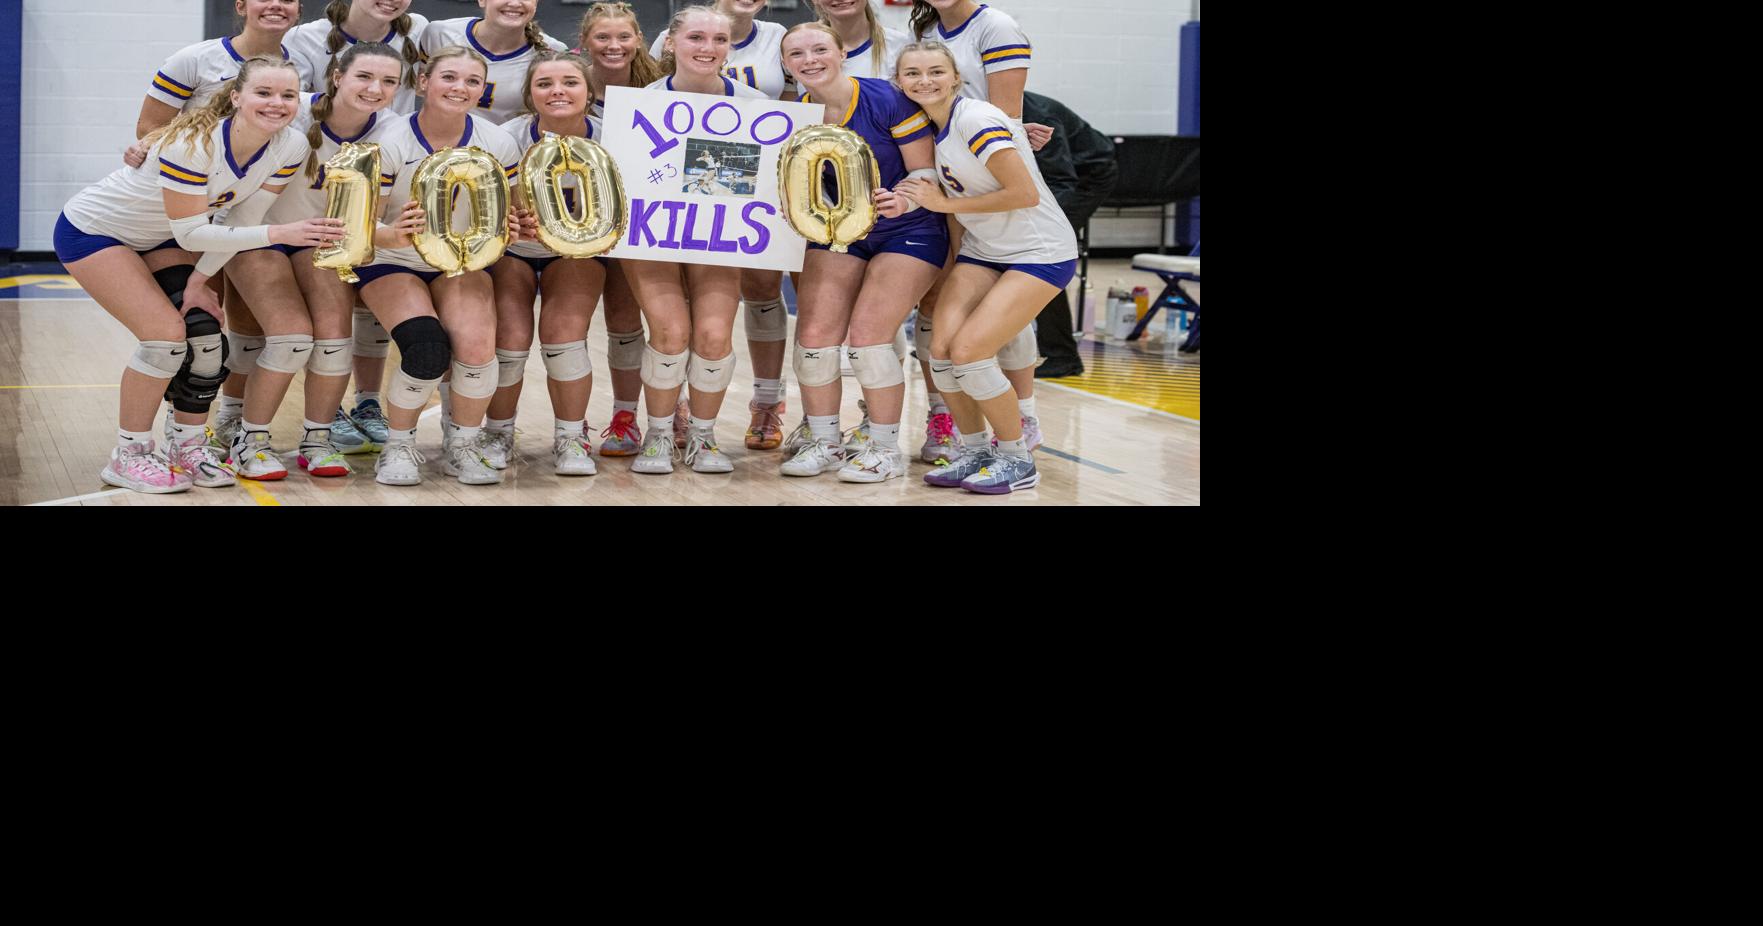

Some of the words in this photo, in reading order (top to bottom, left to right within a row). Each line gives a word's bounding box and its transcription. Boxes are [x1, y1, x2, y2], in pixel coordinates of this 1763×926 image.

[631, 101, 794, 159] 1000
[647, 163, 678, 185] #3
[940, 164, 966, 194] 5
[208, 190, 236, 209] 2
[627, 198, 777, 255] KILLS
